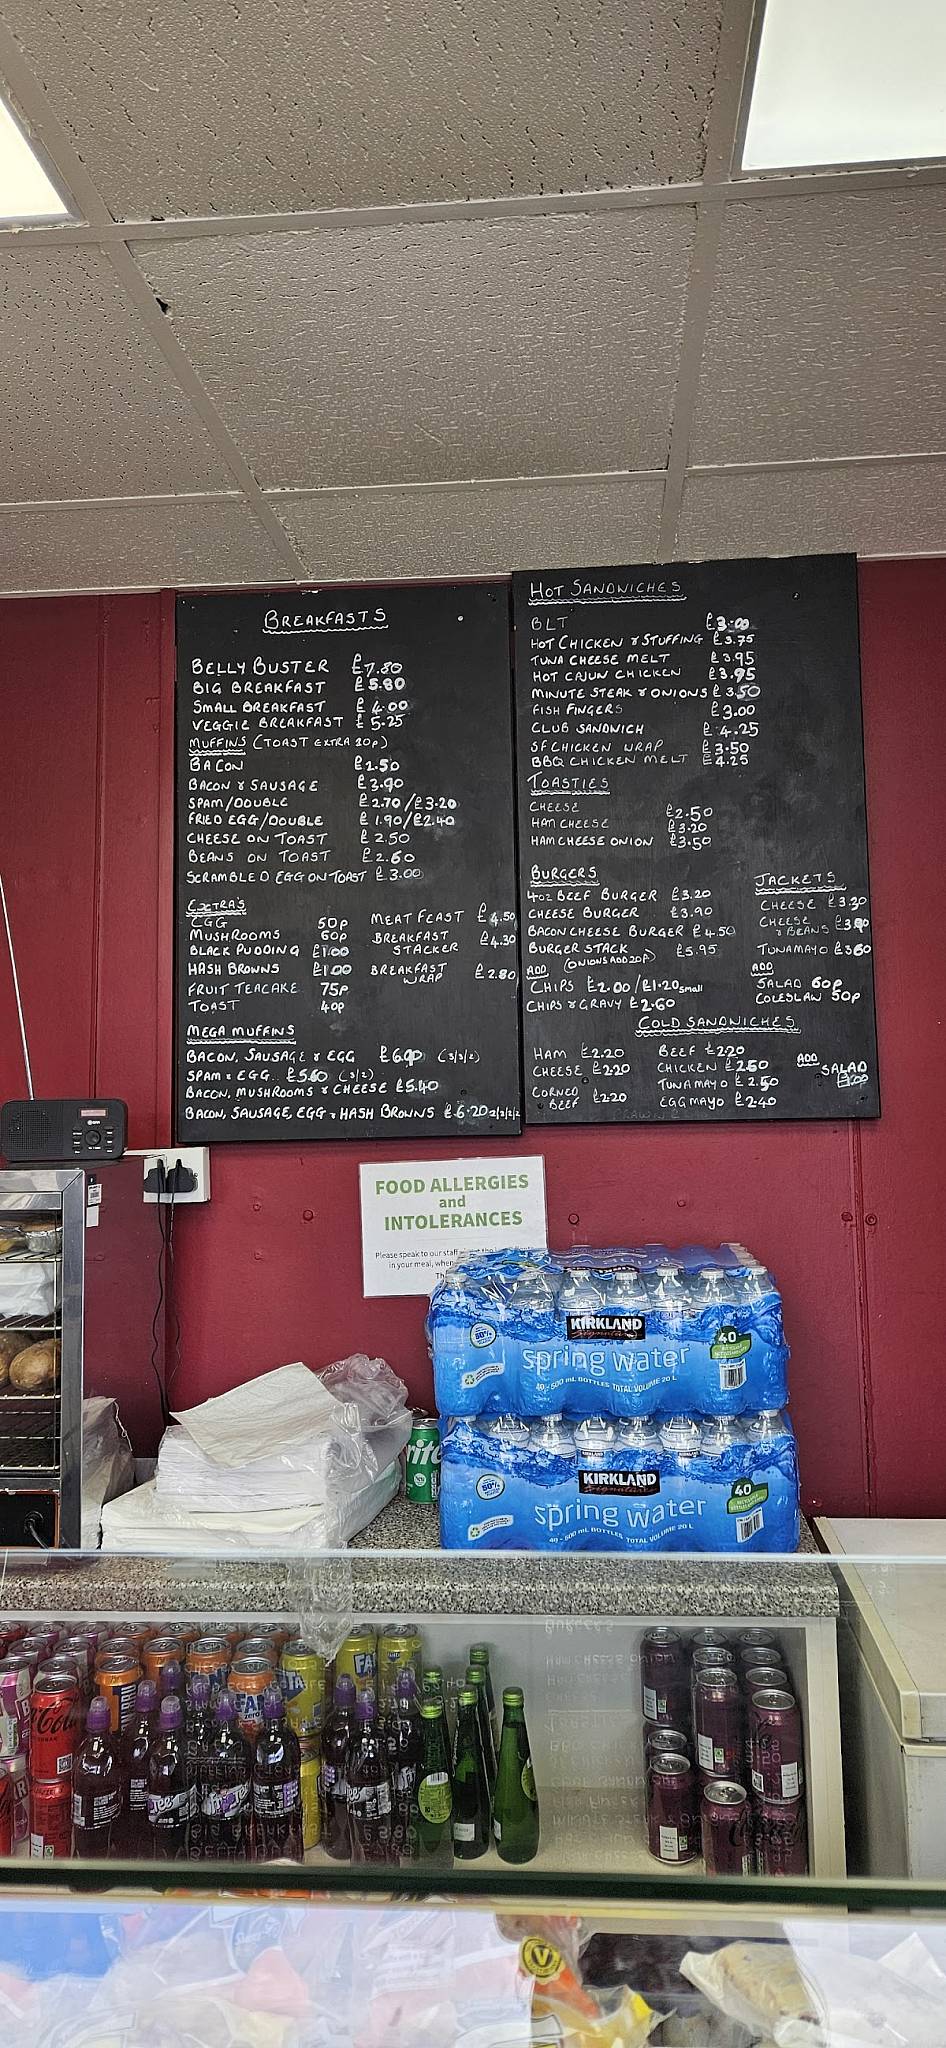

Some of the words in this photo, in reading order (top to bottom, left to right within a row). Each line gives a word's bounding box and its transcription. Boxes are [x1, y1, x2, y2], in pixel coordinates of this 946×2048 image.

[531, 582, 564, 598] HOT
[571, 579, 682, 596] SANDWICHES
[263, 608, 388, 630] BREAKFASTS
[532, 616, 568, 630] BLT
[531, 638, 555, 650] HOT
[559, 635, 623, 649] CHICKEN
[642, 634, 703, 646] STUFFING
[192, 658, 245, 676] BELLY
[253, 656, 329, 675] BUSTER
[530, 655, 563, 666] TUNA
[570, 654, 618, 666] CHEESE
[627, 654, 670, 663] MELT
[534, 671, 558, 682] HOT
[565, 670, 608, 682] CAJUN
[615, 668, 680, 679] CHICKEN
[193, 681, 221, 694] BIG
[232, 680, 326, 694] BREAKFAST
[532, 688, 585, 699] MINUTE
[590, 688, 632, 698] STEAK
[651, 688, 707, 698] ONIONS
[194, 700, 237, 714] SMALL
[243, 700, 326, 713] BREAKFAST
[533, 704, 559, 715] FISH
[566, 703, 622, 716] FINGERS
[192, 719, 249, 732] VEGGIE
[259, 717, 343, 728] BREAKFAST
[532, 722, 568, 733] CLUB
[576, 723, 644, 734] SANDWICH
[190, 736, 246, 748] MUFFINS
[253, 734, 308, 749] (TOAST
[551, 742, 611, 752] CHICKEN
[190, 757, 243, 772] BACON
[532, 755, 564, 767] BBQ
[570, 755, 635, 766] CHICKEN
[644, 754, 688, 763] MELT
[189, 778, 230, 791] BACON
[250, 779, 318, 792] SAUSAGE
[527, 771, 608, 789] TOASTIES
[530, 802, 579, 812] CHEESE
[189, 812, 222, 825] FRIED
[560, 819, 608, 828] CHEESE
[187, 833, 240, 845] CHEESE
[247, 834, 269, 842] ON
[274, 832, 328, 844] TOAST
[558, 836, 604, 846] CHEESE
[610, 837, 653, 846] ONION
[189, 849, 233, 863] BEANS
[248, 853, 266, 862] ON
[279, 850, 331, 862] TOAST
[276, 871, 305, 884] EGG
[328, 870, 367, 883] TOAST
[532, 864, 596, 880] BURGERS
[754, 872, 835, 886] JACKETS
[558, 890, 591, 901] BEEF
[601, 888, 657, 902] BURGER
[761, 899, 816, 910] CHEESE
[371, 913, 412, 925] MEAT
[528, 908, 574, 919] CHEESE
[583, 906, 639, 918] BURGER
[318, 917, 348, 932] 50p
[760, 916, 810, 928] CHEESE
[786, 922, 829, 936] BEANS
[190, 929, 280, 941] MUSHROOMS
[321, 930, 347, 943] 60p
[372, 930, 448, 944] BREAKFAST
[528, 925, 566, 936] BACON
[570, 927, 620, 937] CHEESE
[629, 925, 683, 938] BURGER
[190, 945, 230, 956] BLACK
[237, 943, 299, 956] PUDDING
[391, 941, 458, 955] STACKER
[529, 942, 580, 955] BURGER
[584, 943, 628, 953] STACK
[188, 962, 221, 976] HASH
[228, 962, 279, 975] BROWNS
[370, 963, 447, 976] BREAKFAST
[188, 982, 230, 996] FRUIT
[234, 982, 297, 994] TEACAKE
[530, 979, 574, 994] CHIPS
[757, 977, 801, 989] SALAD
[756, 992, 821, 1004] COLESLAW
[188, 1000, 240, 1014] TOAST
[526, 1000, 562, 1012] CHIPS
[579, 999, 622, 1010] GRAVY
[638, 1016, 680, 1029] COLD
[686, 1016, 794, 1028] SANDWICHES
[187, 1025, 225, 1038] MEGA
[232, 1025, 294, 1036] MUFFINS
[244, 1048, 305, 1064] SAUSAGE
[327, 1050, 354, 1063] EGG
[534, 1048, 566, 1060] HAM
[659, 1044, 695, 1057] BEEF
[533, 1065, 582, 1077] CHEESE
[658, 1062, 716, 1073] CHICKEN
[821, 1061, 868, 1076] SALAD
[187, 1070, 220, 1082] SPAM
[236, 1086, 313, 1098] MUSHROOMS
[333, 1081, 387, 1094] CHEESE
[532, 1086, 579, 1100] CORNED
[549, 1097, 579, 1110] BEEF
[660, 1096, 686, 1108] EGG
[297, 1107, 326, 1120] EGG
[340, 1107, 374, 1120] HASH
[381, 1104, 434, 1118] BROWNS
[375, 1180, 426, 1195] FOOD
[430, 1174, 529, 1193] ALLERGIES
[439, 1195, 466, 1208] and
[385, 1211, 523, 1230] INTOLERANCES
[571, 1317, 642, 1330] KIRKLAND
[719, 1331, 736, 1343] 40
[523, 1345, 606, 1376] spring
[612, 1347, 689, 1372] water
[578, 1377, 610, 1388] BOTTLES
[612, 1384, 633, 1393] TOTAL
[633, 1380, 660, 1393] VOLUME
[661, 1376, 670, 1384] 20
[583, 1472, 657, 1486] KIRKLAND
[482, 1481, 500, 1492] 50%
[735, 1484, 751, 1496] 40
[534, 1499, 619, 1531] spring
[627, 1499, 707, 1529] water
[591, 1527, 623, 1539] BOTTLES
[650, 1525, 675, 1542] VOLUME
